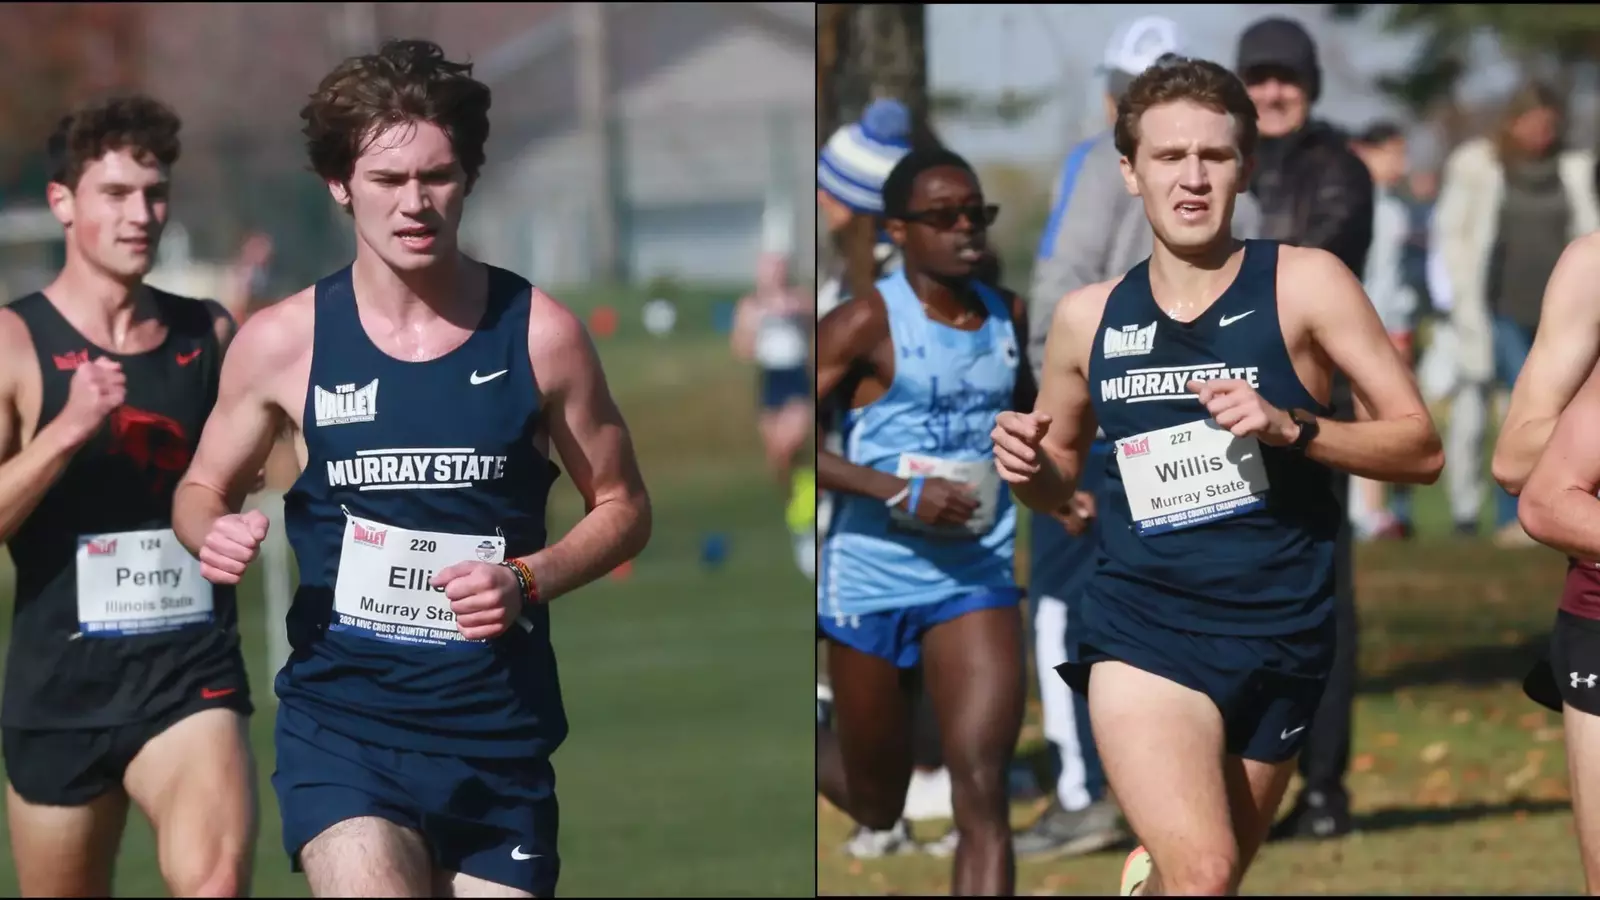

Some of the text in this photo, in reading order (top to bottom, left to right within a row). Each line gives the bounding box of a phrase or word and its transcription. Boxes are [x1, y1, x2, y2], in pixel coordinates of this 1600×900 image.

[1103, 320, 1157, 354] VALLEY
[336, 383, 355, 394] THE
[1101, 371, 1190, 402] MURRAY
[314, 378, 379, 420] VALLEY
[1170, 431, 1192, 445] 227
[327, 455, 507, 487] MURRAY STATE
[1155, 455, 1224, 483] Willis
[1151, 480, 1245, 510] Murray State
[1167, 511, 1187, 523] CROSS
[1187, 505, 1215, 518] COUNTRY
[140, 539, 161, 551] 124
[410, 539, 437, 553] 220
[116, 567, 183, 588] Penry
[105, 596, 193, 613] Illinois State
[360, 596, 458, 622] Murray Sta
[339, 615, 355, 626] 2024
[356, 618, 372, 630] MVC
[372, 622, 396, 633] CROSS
[396, 625, 429, 638] COUNTRY
